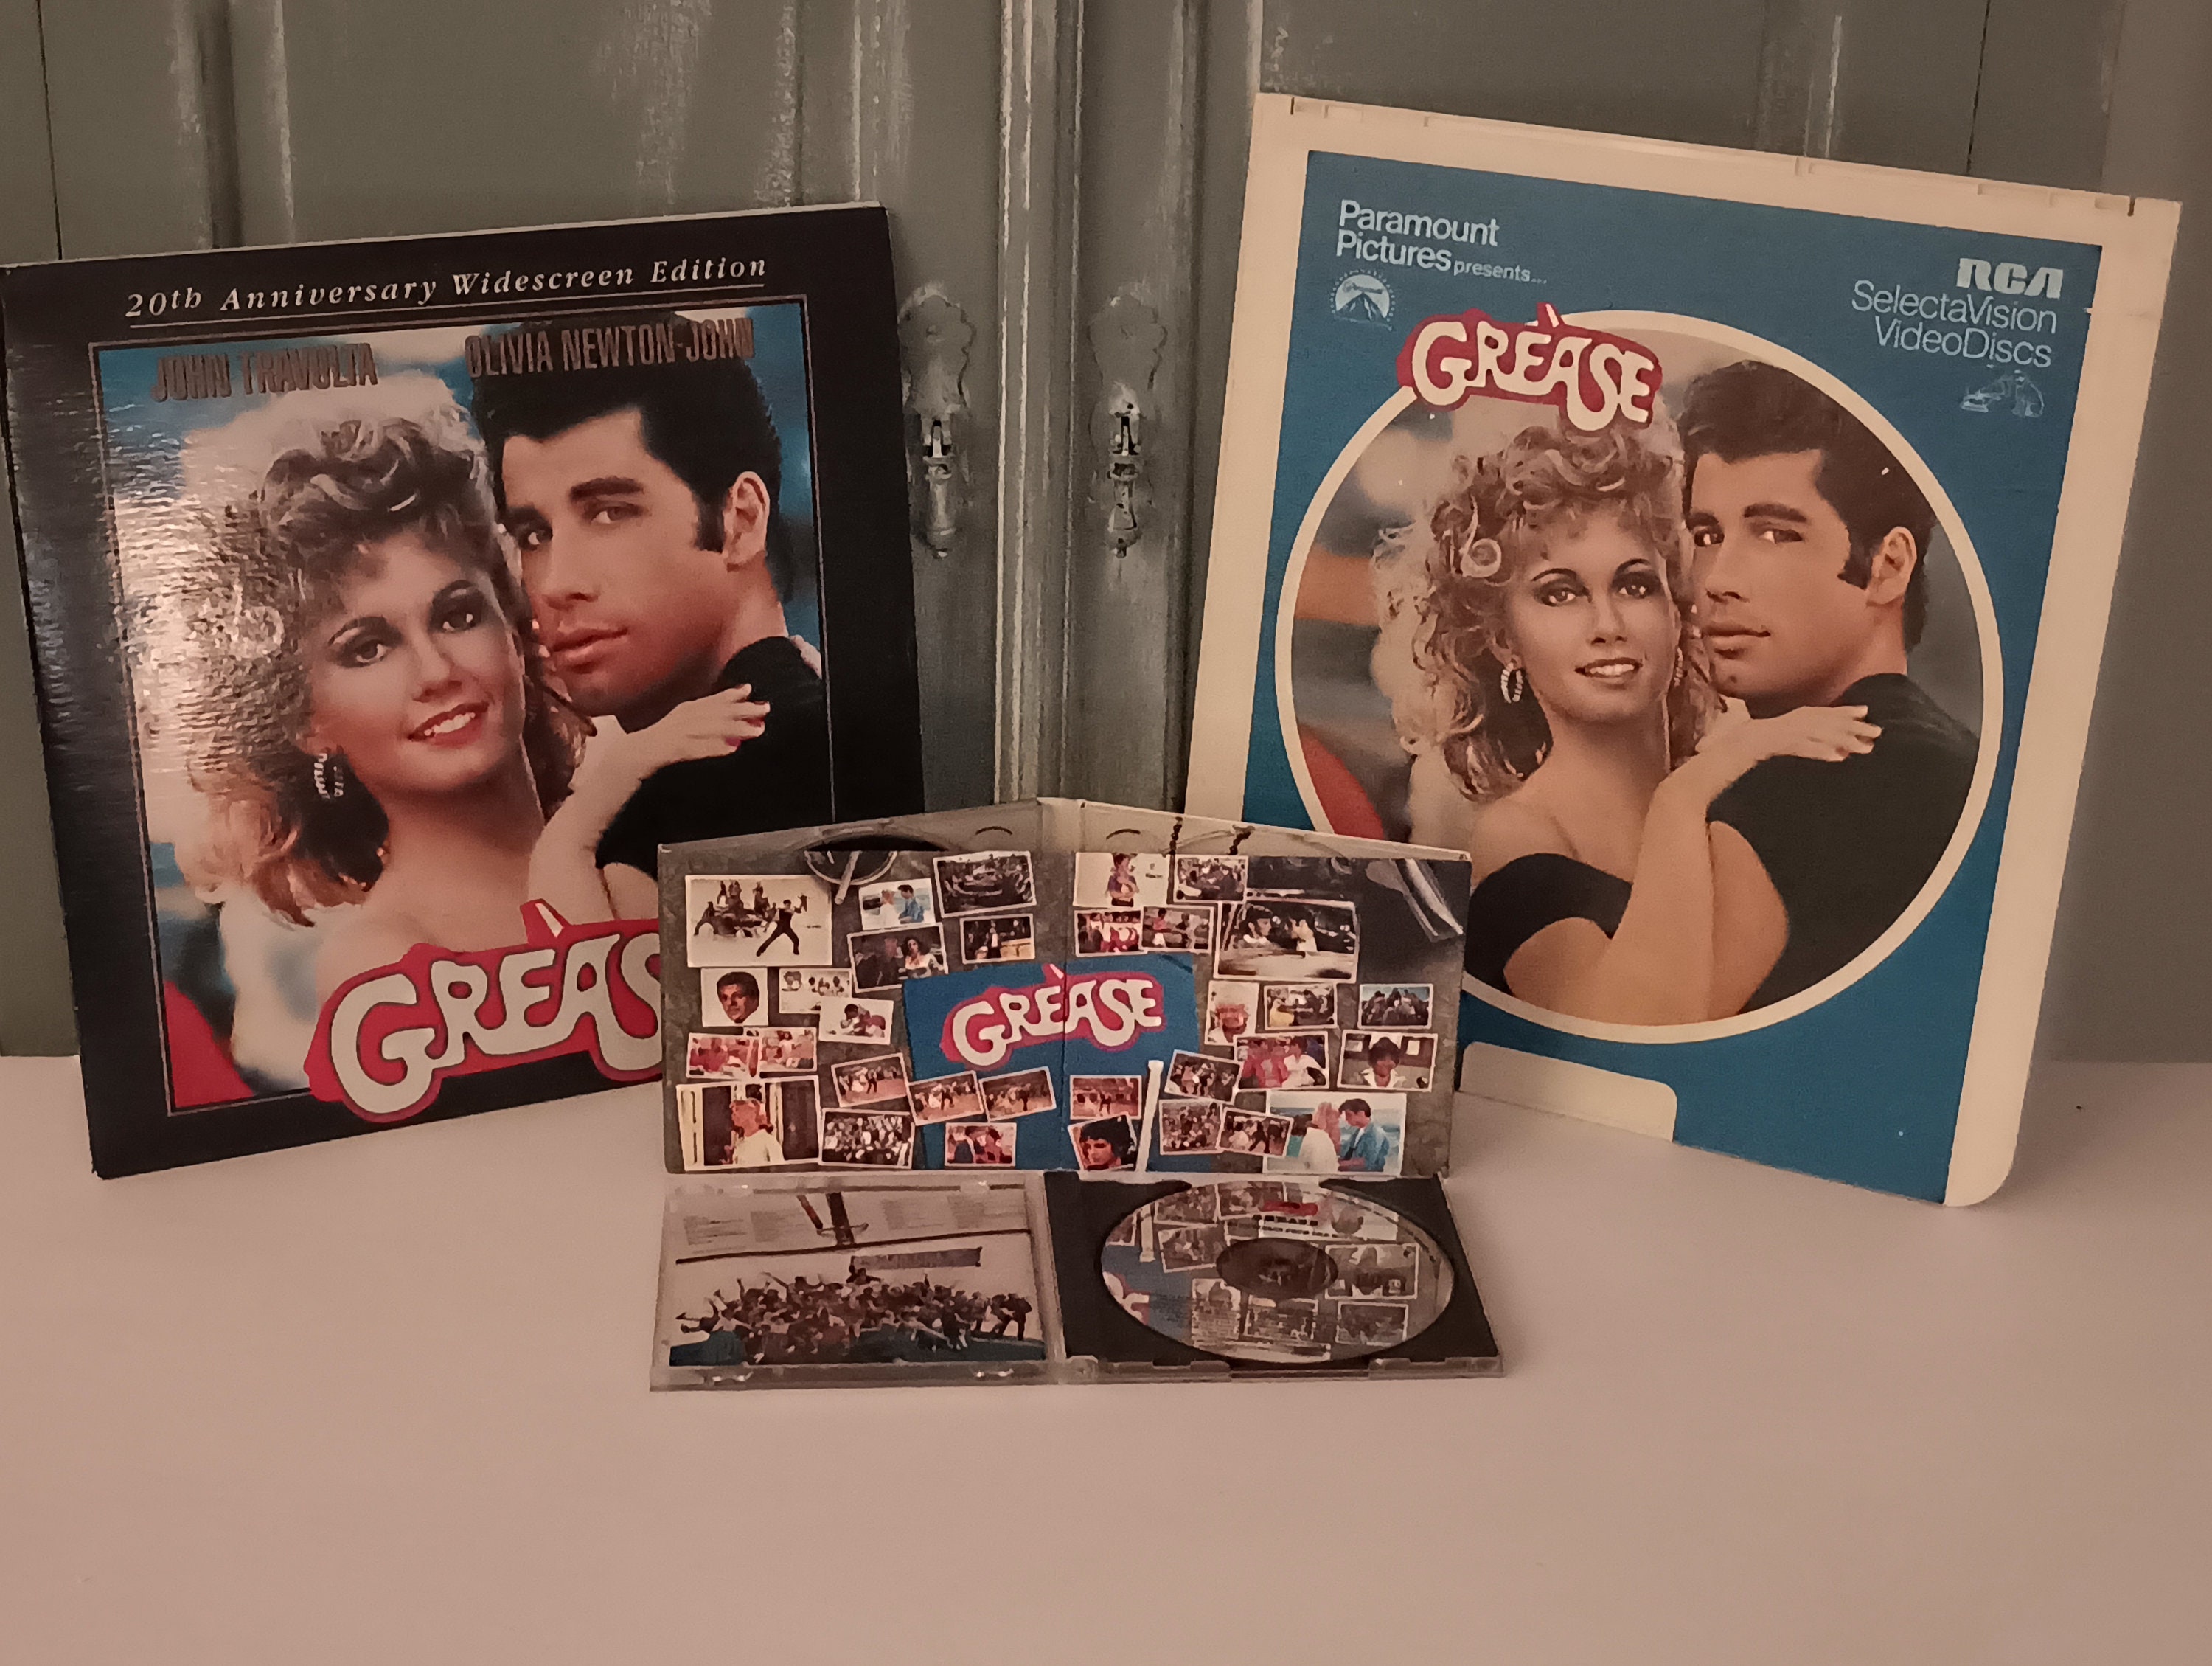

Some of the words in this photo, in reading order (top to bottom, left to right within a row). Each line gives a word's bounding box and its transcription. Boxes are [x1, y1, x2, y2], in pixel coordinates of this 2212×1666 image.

[1335, 229, 1453, 271] Pictures
[1339, 199, 1499, 247] Paramount
[125, 287, 202, 317] 20th
[220, 278, 437, 311] Anniversary
[452, 268, 634, 296] Widescreen
[650, 257, 768, 283] Edition
[1851, 280, 2056, 334] SelectaVision
[1956, 257, 2065, 299] RCA
[150, 354, 233, 402] JOHN
[240, 342, 379, 395] TRAVOLTA
[465, 330, 553, 378] OLIVIA
[560, 317, 756, 372] NEWTON-JOHN
[1411, 304, 1655, 432] GREASE
[1874, 316, 2052, 369] VideoDiscs
[331, 904, 663, 1114] GREAS
[952, 965, 1163, 1067] GREASE
